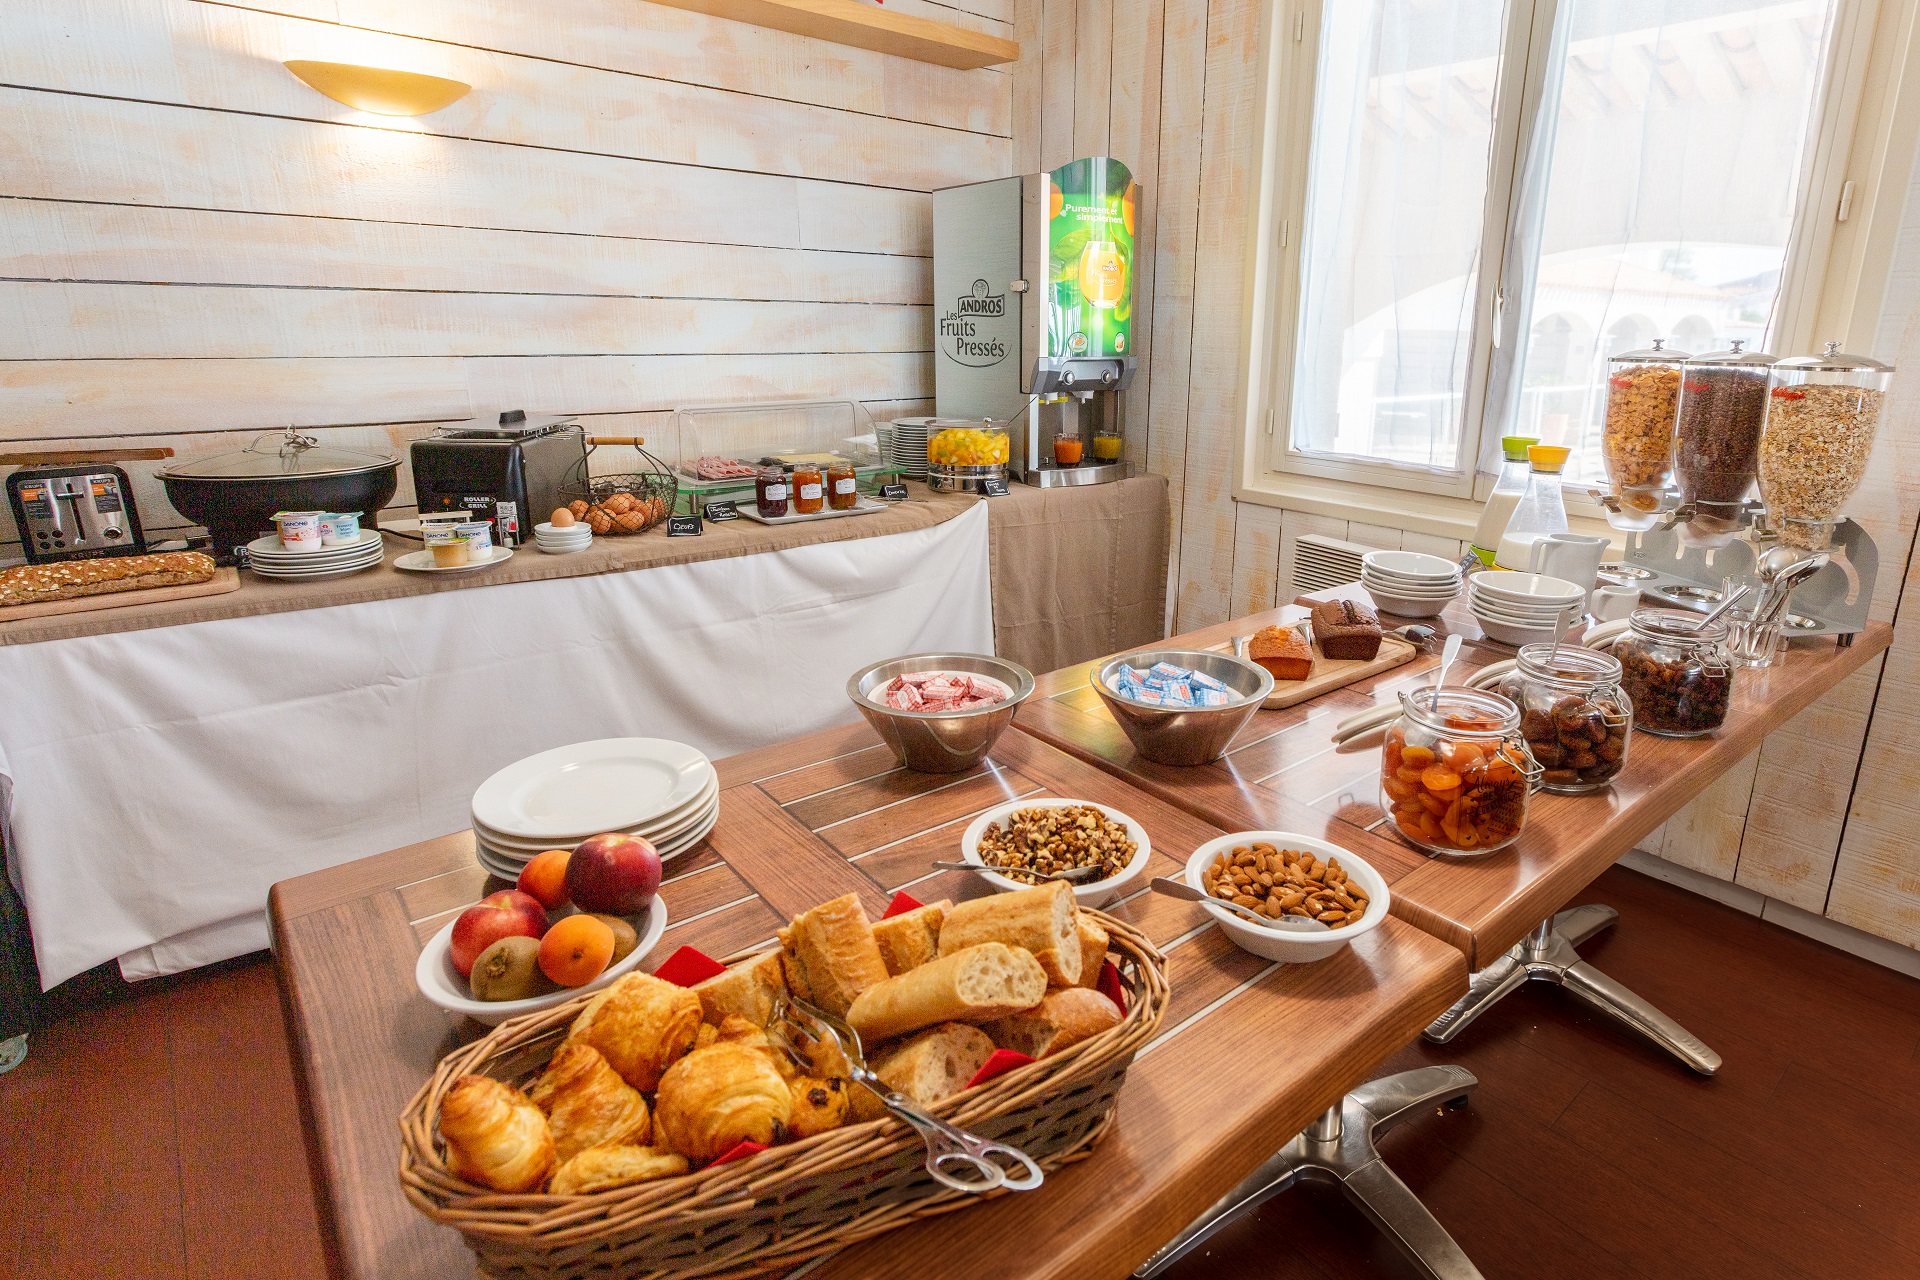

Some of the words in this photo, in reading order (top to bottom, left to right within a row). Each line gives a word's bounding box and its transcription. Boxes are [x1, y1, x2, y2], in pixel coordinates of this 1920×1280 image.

[1065, 203, 1110, 215] Purement
[1110, 208, 1118, 216] et
[1076, 213, 1123, 224] simplement
[959, 298, 1002, 314] ANDROS
[946, 310, 958, 321] Les
[940, 317, 976, 337] Fruits
[956, 336, 1005, 358] Pressés
[1471, 774, 1511, 796] Always
